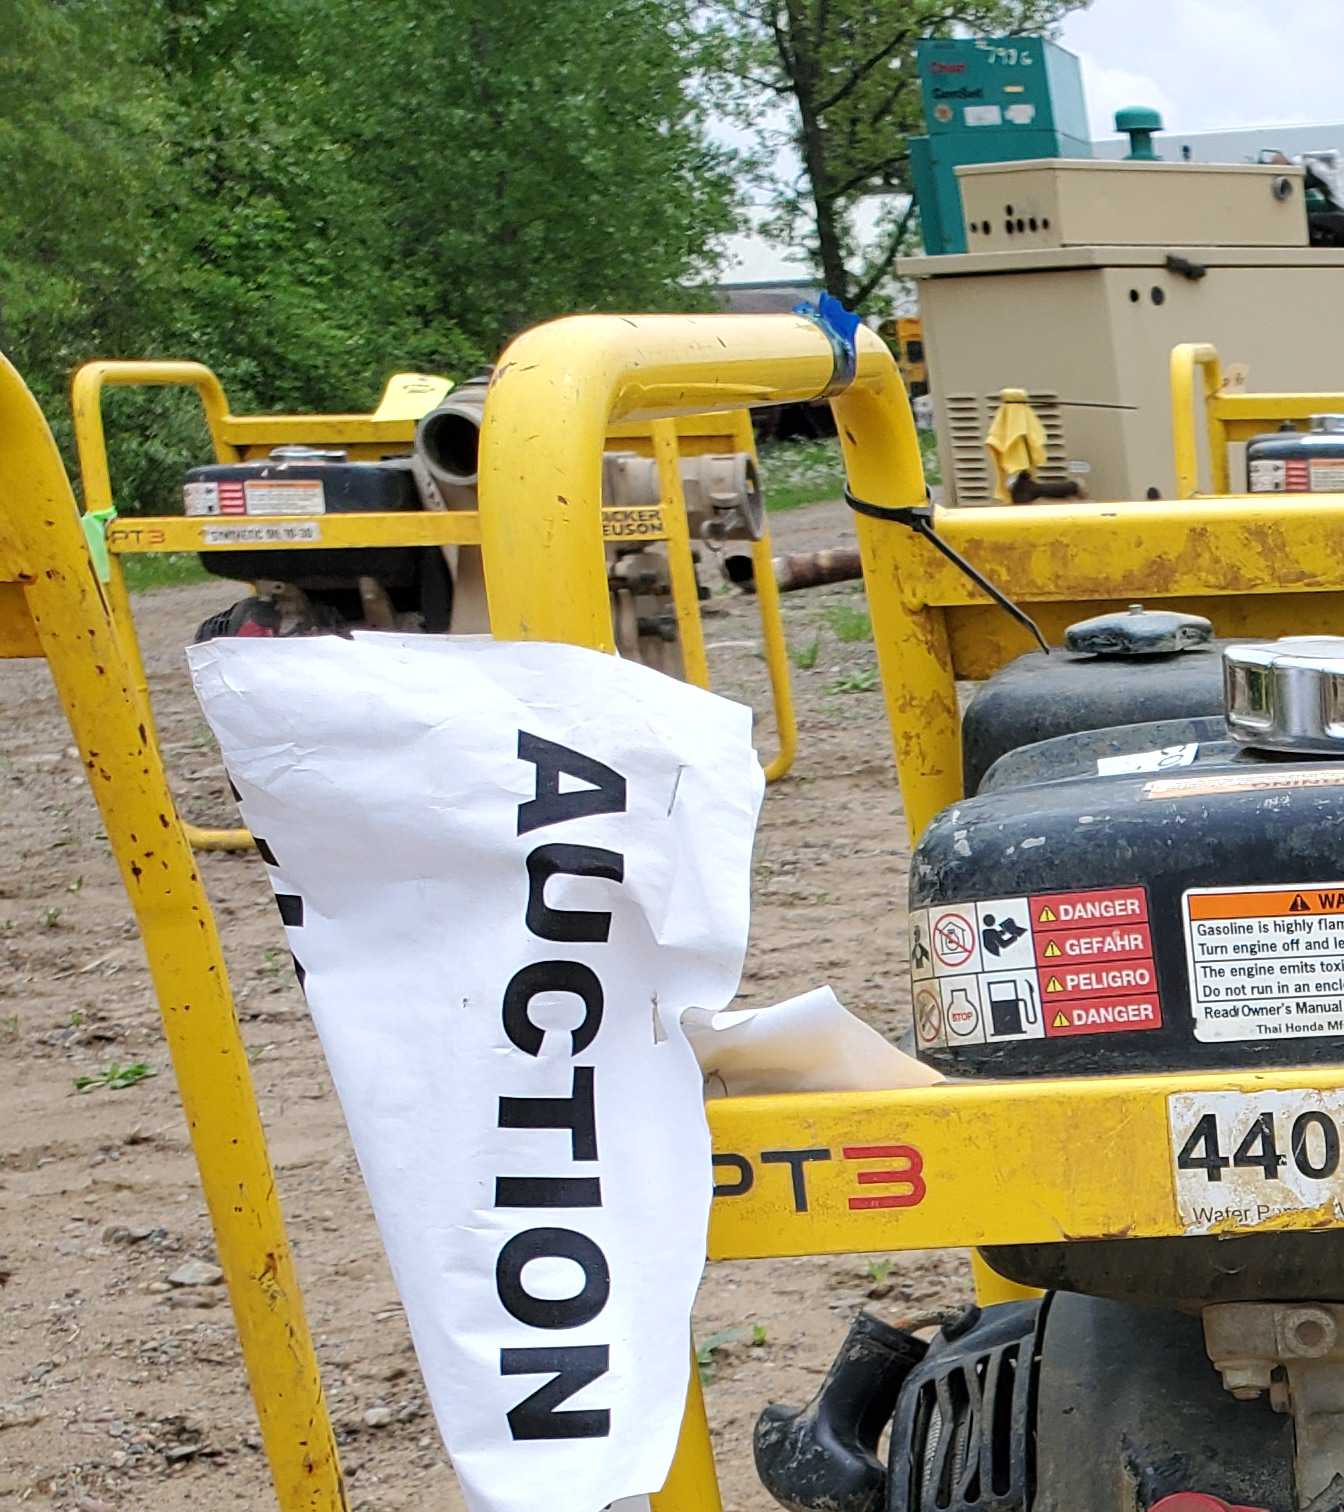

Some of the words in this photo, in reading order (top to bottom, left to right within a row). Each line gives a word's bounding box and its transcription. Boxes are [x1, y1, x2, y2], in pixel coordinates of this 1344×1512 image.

[602, 510, 661, 524] ACKER
[602, 523, 664, 536] EUSON
[1059, 899, 1141, 922] DANGER
[1197, 921, 1254, 936] Gasoline
[1258, 920, 1270, 934] is
[1273, 919, 1314, 935] highly
[1065, 933, 1144, 957] GEFAHR
[1198, 942, 1229, 956] Turn
[1232, 940, 1278, 956] engine
[1281, 938, 1301, 952] off
[1304, 937, 1330, 951] and
[1201, 965, 1226, 979] The
[1230, 963, 1275, 979] engine
[1279, 961, 1316, 975] emits
[1066, 968, 1151, 992] PELIGRO
[1202, 985, 1221, 998] Do
[1225, 983, 1247, 997] not
[1250, 984, 1273, 996] run
[1276, 981, 1290, 994] in
[1293, 983, 1311, 994] an
[952, 1012, 973, 1023] STOP
[1072, 1004, 1155, 1026] DANGER
[1204, 1006, 1237, 1019] Read
[1241, 1003, 1292, 1017] Owner's
[1295, 1000, 1343, 1015] Manual
[1256, 1023, 1282, 1035] Thai
[1285, 1021, 1324, 1033] Honda
[495, 729, 628, 1442] AUCTION
[711, 1144, 927, 1213] PT3
